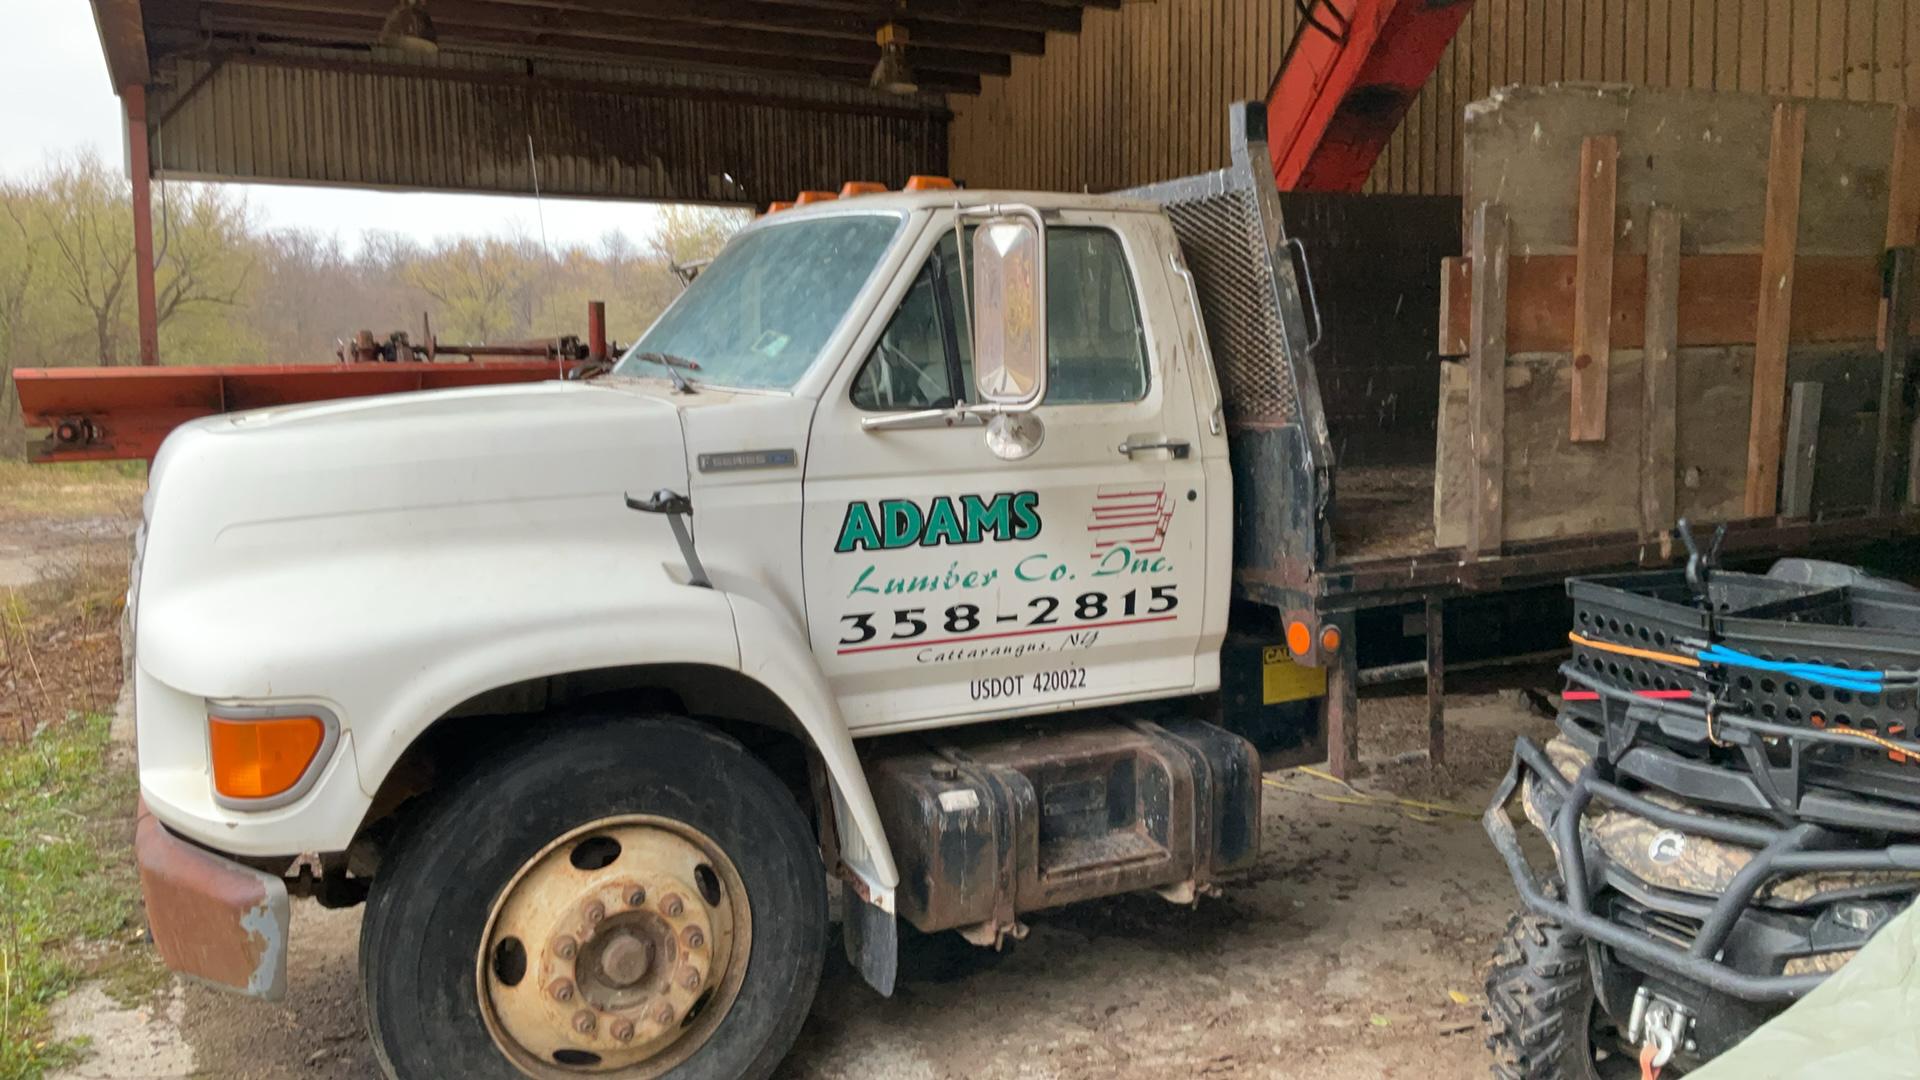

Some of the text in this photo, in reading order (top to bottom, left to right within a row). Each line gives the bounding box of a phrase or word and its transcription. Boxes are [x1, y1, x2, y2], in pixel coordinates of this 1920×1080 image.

[834, 490, 1042, 553] ADAMS
[847, 547, 1174, 598] Lumber Co. Inc.
[839, 584, 1179, 645] 358-2815
[1060, 629, 1100, 653] NY
[970, 667, 1087, 700] USDOT 420022
